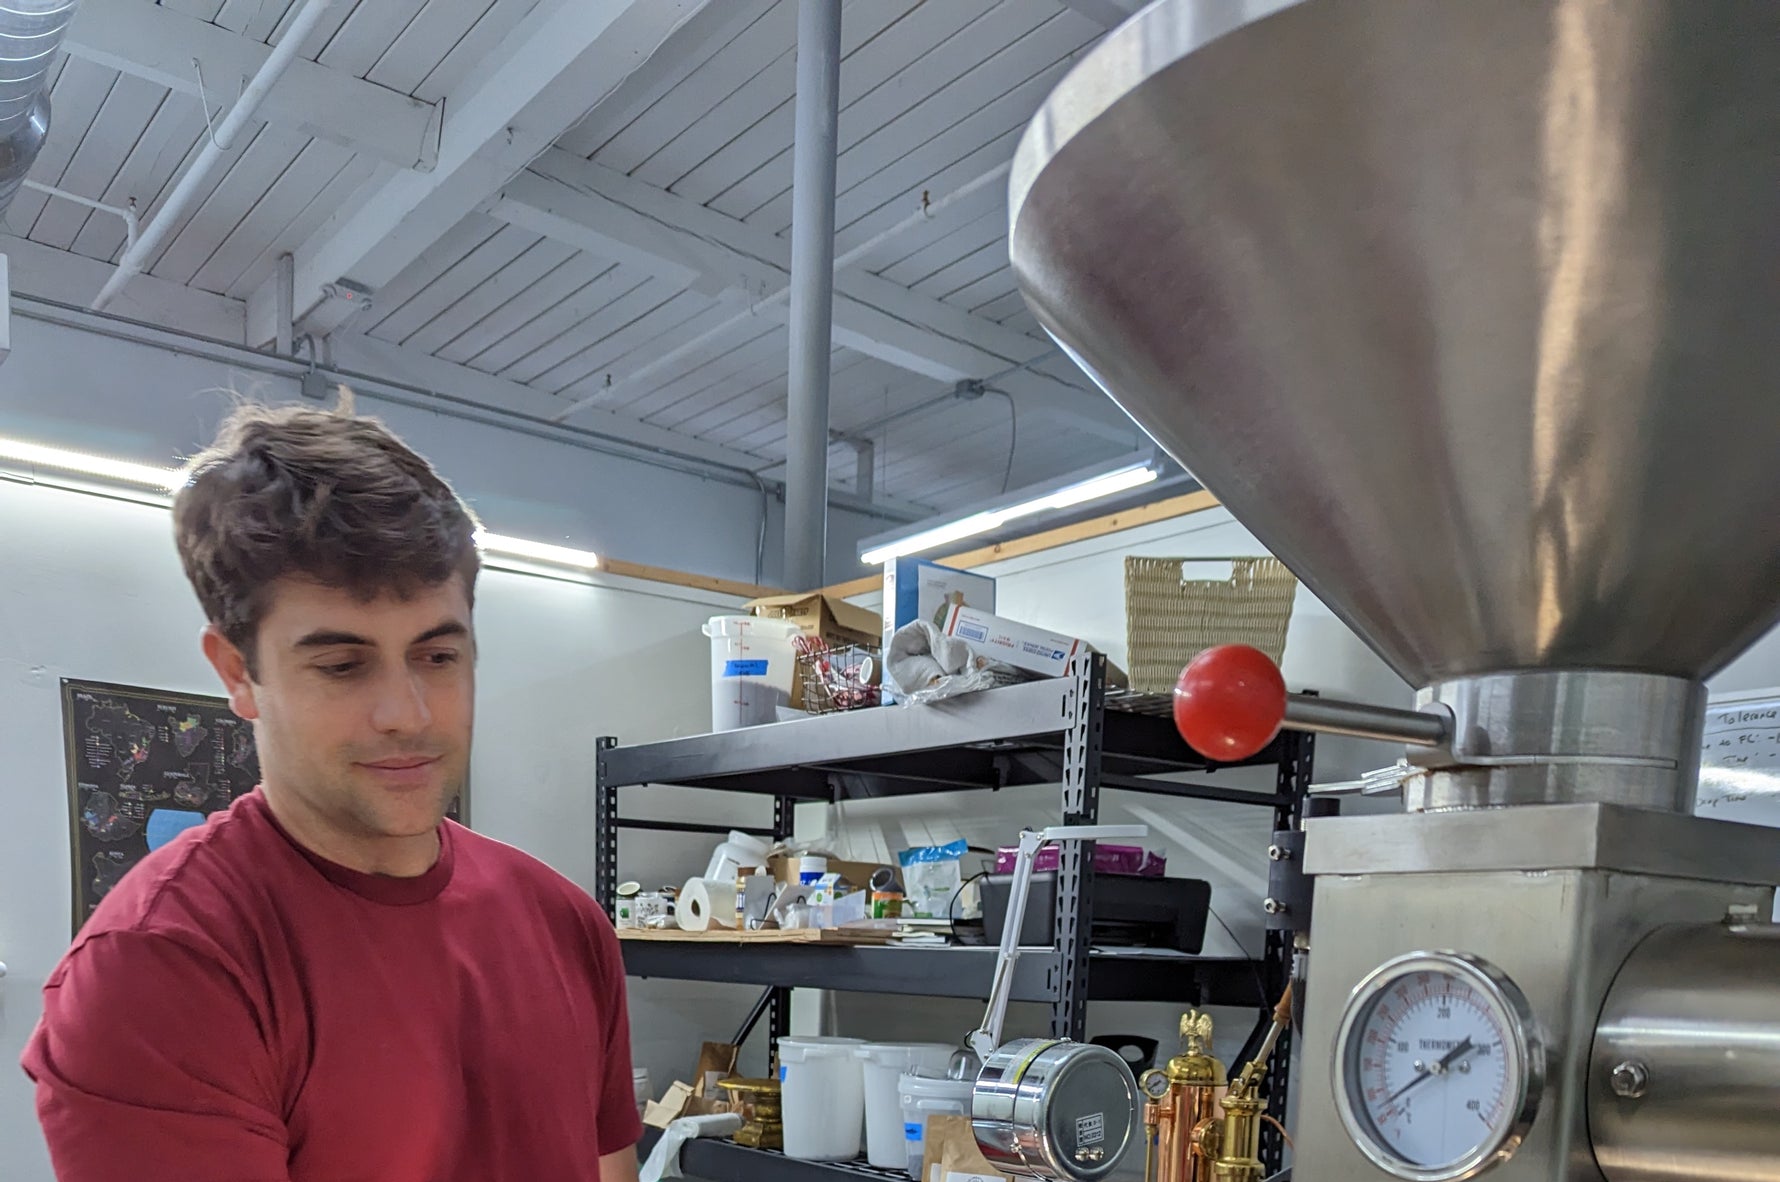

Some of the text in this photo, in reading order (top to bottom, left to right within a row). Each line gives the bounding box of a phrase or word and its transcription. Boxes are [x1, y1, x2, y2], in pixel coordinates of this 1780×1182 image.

[1717, 710, 1777, 725] Tolerance
[1436, 1007, 1451, 1018] 200
[1397, 1041, 1410, 1052] 100
[1477, 1043, 1491, 1055] 300
[1466, 1099, 1481, 1111] 400
